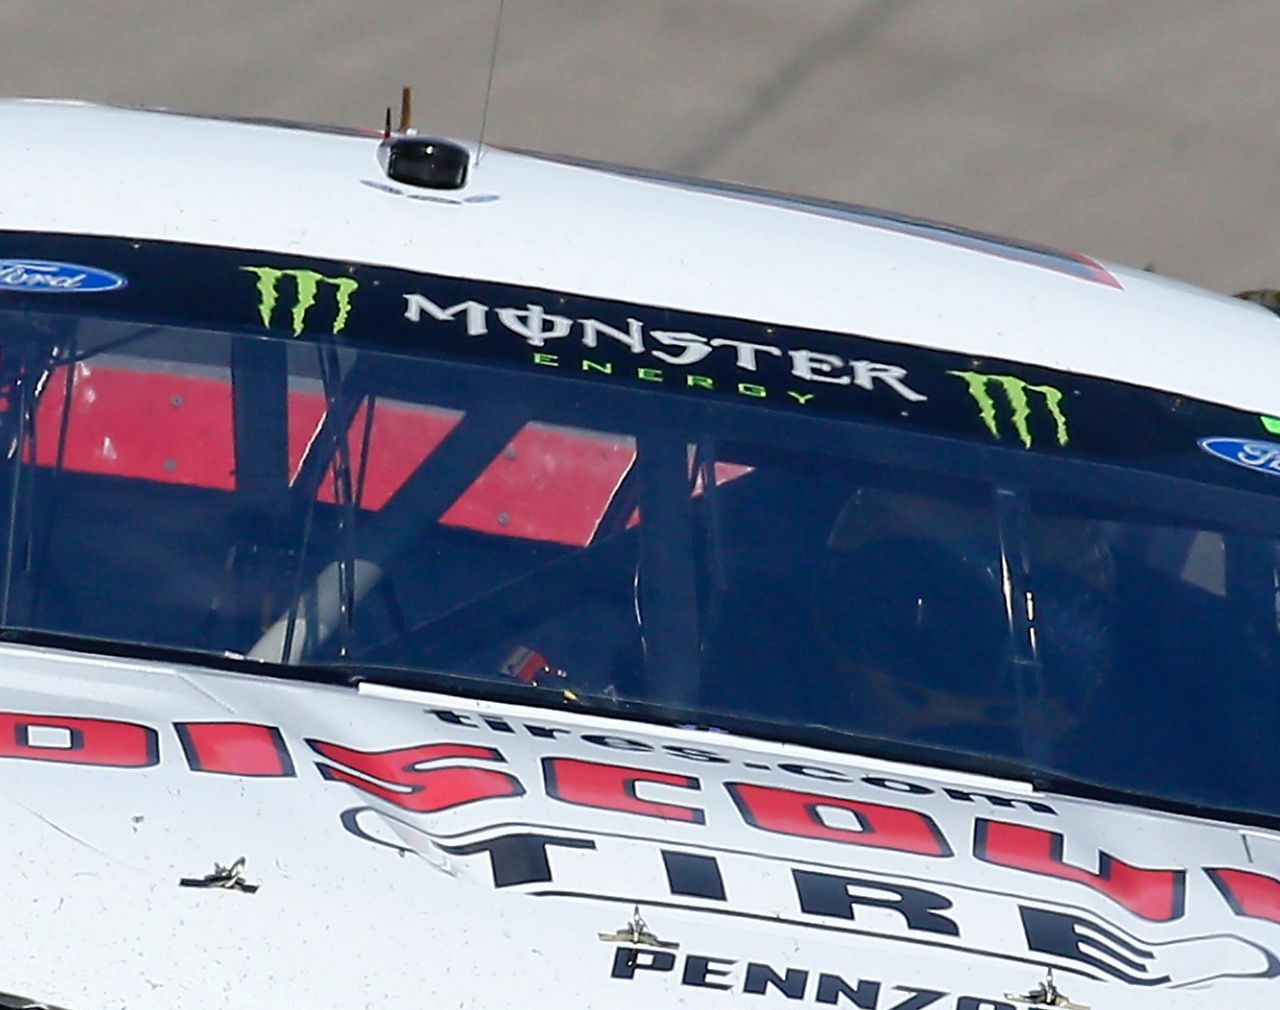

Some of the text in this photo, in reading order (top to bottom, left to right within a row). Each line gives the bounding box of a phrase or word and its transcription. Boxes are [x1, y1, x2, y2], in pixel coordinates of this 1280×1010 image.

[403, 293, 927, 402] MONSTER
[534, 352, 815, 404] ENERGY
[423, 707, 1059, 816] tires.com
[432, 831, 1173, 986] TIRE
